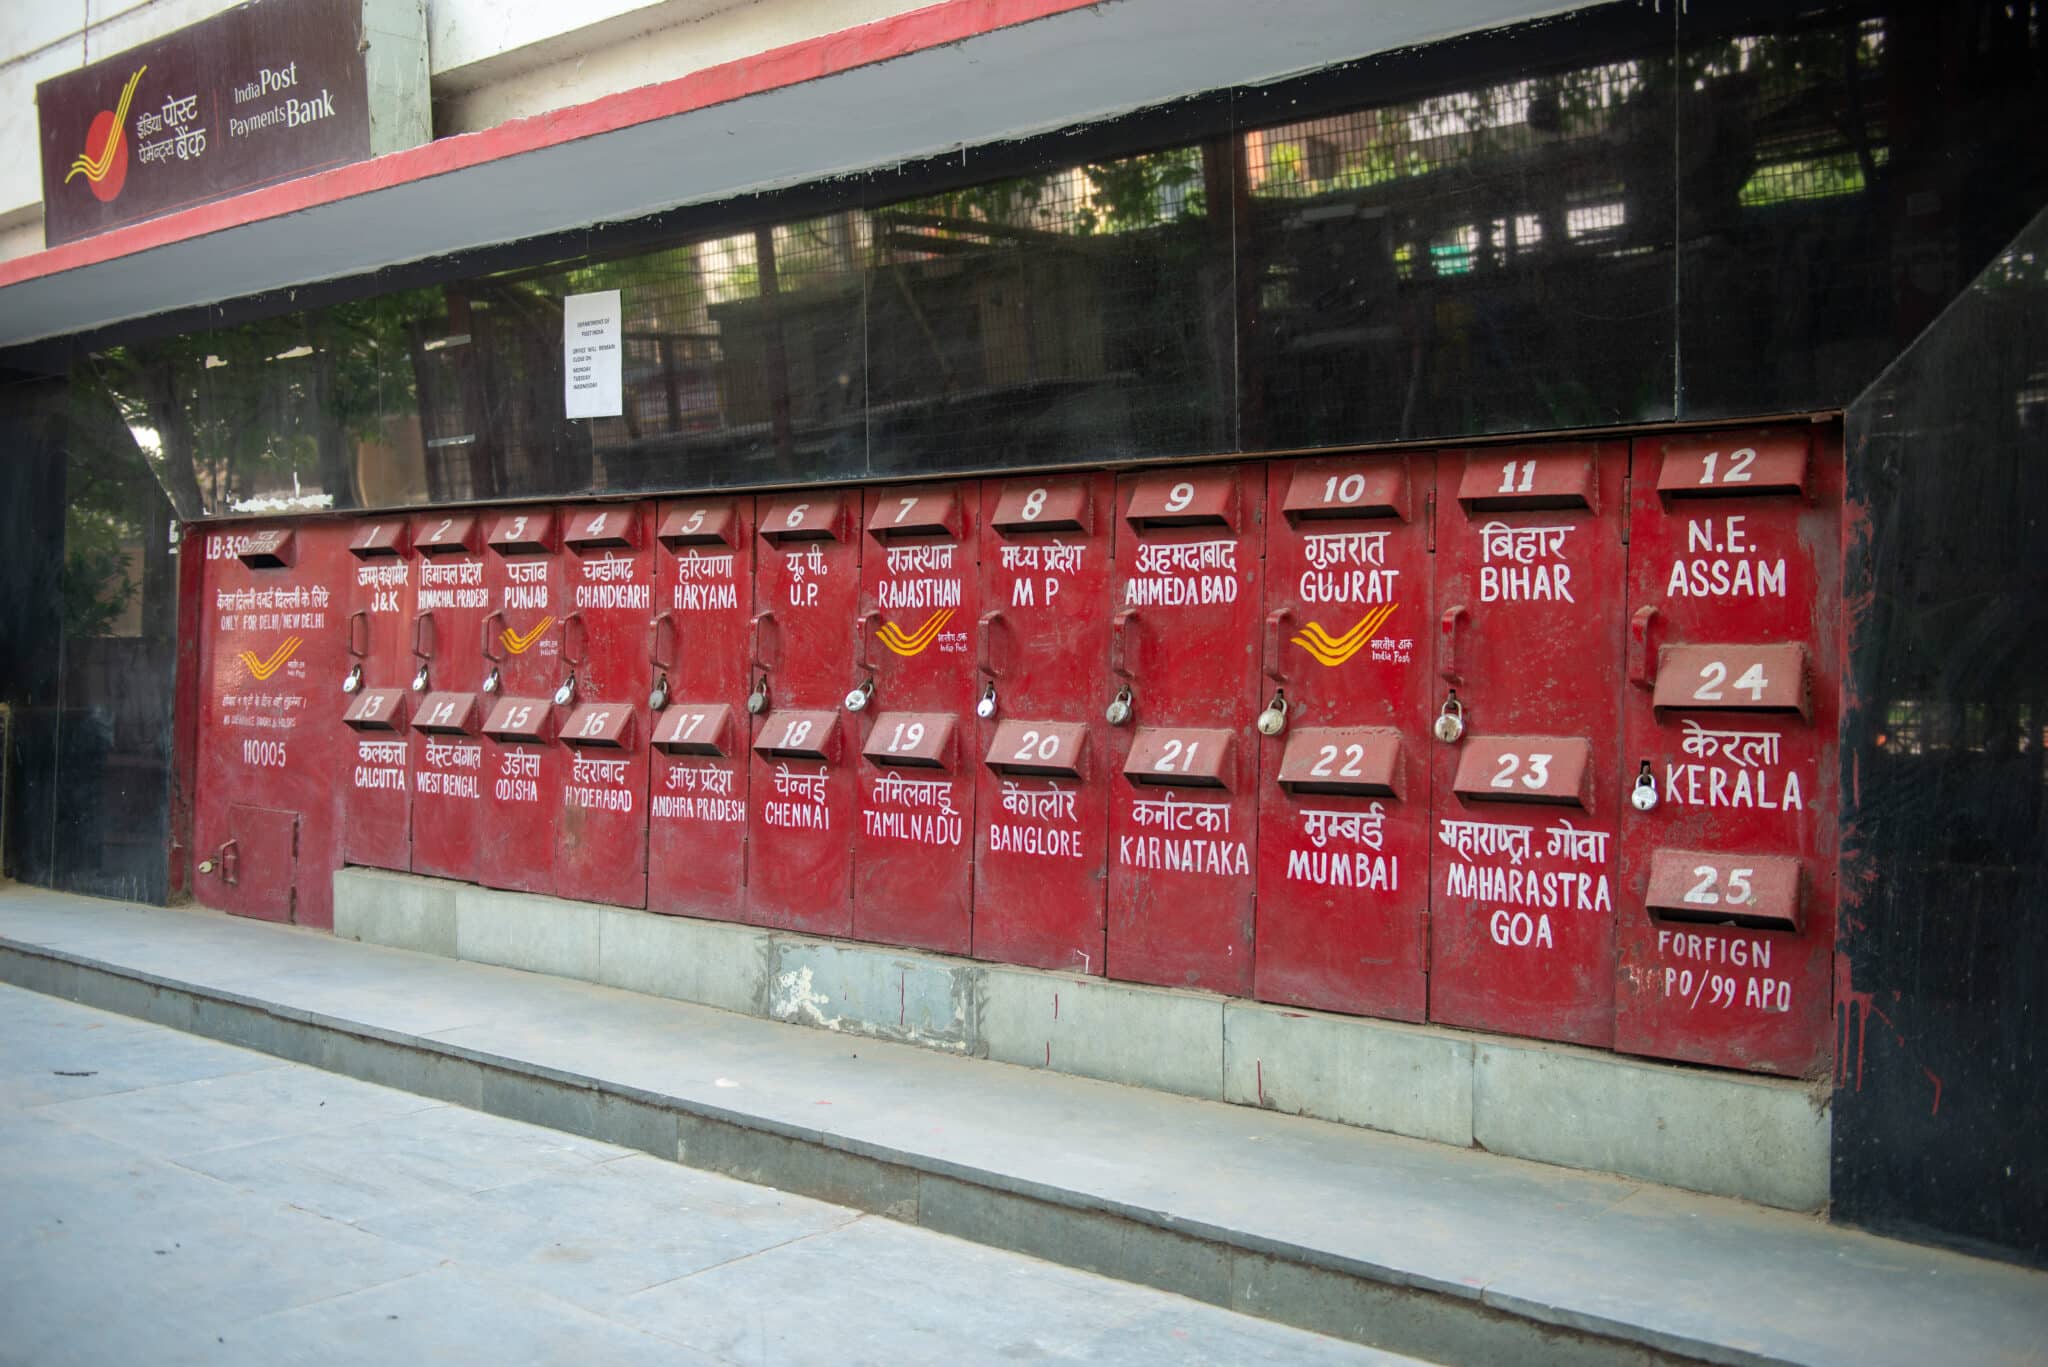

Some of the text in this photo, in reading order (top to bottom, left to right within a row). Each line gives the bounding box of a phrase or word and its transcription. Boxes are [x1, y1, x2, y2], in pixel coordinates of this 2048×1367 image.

[233, 61, 298, 104] India Post
[136, 94, 198, 139] इंडिया पोस्ट
[229, 89, 336, 139] Payments Bank
[175, 125, 207, 160] बैंक
[1498, 460, 1537, 494] 11
[1700, 448, 1756, 485] 12
[1022, 488, 1047, 521] 8
[1165, 483, 1194, 513] 9
[1323, 474, 1366, 504] 10
[586, 512, 608, 536] 4
[681, 510, 706, 535] 5
[785, 504, 809, 528] 6
[894, 497, 919, 523] 7
[364, 525, 380, 548] 1
[430, 519, 452, 542] 2
[505, 516, 528, 540] 3
[1479, 521, 1576, 565] बिहार
[1688, 515, 1756, 554] N.E.
[887, 544, 958, 575] राजस्थान
[1000, 538, 1087, 575] मध्य प्रदेश
[1136, 540, 1238, 575] अहमदाबाद
[1303, 531, 1392, 570] गुजरात
[421, 557, 484, 587] हिमाचल प्रदेश
[677, 549, 733, 585] हरियाणा
[1667, 559, 1786, 599] ASSAM
[275, 585, 300, 609] दिल्ली
[418, 587, 489, 609] HIMACHAL PRADESH
[504, 585, 548, 609] PUNJAB
[576, 584, 650, 609] CHANDIGARH
[674, 583, 738, 610] HARYANA
[878, 578, 961, 609] RAJASTHAN
[1299, 570, 1399, 604] GUJRAT
[1480, 564, 1575, 604] BIHAR
[371, 590, 400, 613] J&K
[1372, 650, 1391, 661] India
[1692, 661, 1768, 702] 24
[356, 695, 384, 720] 13
[427, 702, 455, 725] 14
[501, 706, 532, 729] 15
[578, 711, 609, 738] 16
[669, 713, 705, 742] 17
[777, 720, 812, 749] 18
[887, 722, 925, 753] 19
[243, 739, 287, 768] 110005
[359, 740, 408, 767] कलकत्ता
[452, 739, 482, 769] बंगाल
[1014, 730, 1060, 761] 20
[1154, 739, 1199, 772] 21
[1681, 719, 1782, 767] केरला
[1310, 744, 1364, 777] 22
[1490, 753, 1552, 790] 23
[355, 766, 406, 790] CALCUTTA
[417, 771, 480, 799] WEST BENGAL
[495, 779, 538, 802] ODISHA
[666, 762, 734, 798] आंध्र प्रदेश
[774, 762, 830, 805] चैन्नई
[1665, 763, 1803, 811] KERALA
[565, 786, 632, 813] HYDERABAD
[652, 796, 745, 822] ANDHRA PRADESH
[1002, 781, 1078, 822] बेंगलोर
[765, 801, 830, 831] CHENNAI
[1299, 801, 1386, 849] मुम्बई
[990, 824, 1084, 858] BANGLORE
[1119, 835, 1249, 876] KARNATAKA
[1546, 818, 1610, 864] गोवा
[1287, 850, 1397, 891] MUMBAI
[1683, 865, 1755, 905] 25
[1446, 863, 1612, 912] MAHARASTRA
[1490, 910, 1553, 949] GOA
[1745, 976, 1792, 1012] APO
